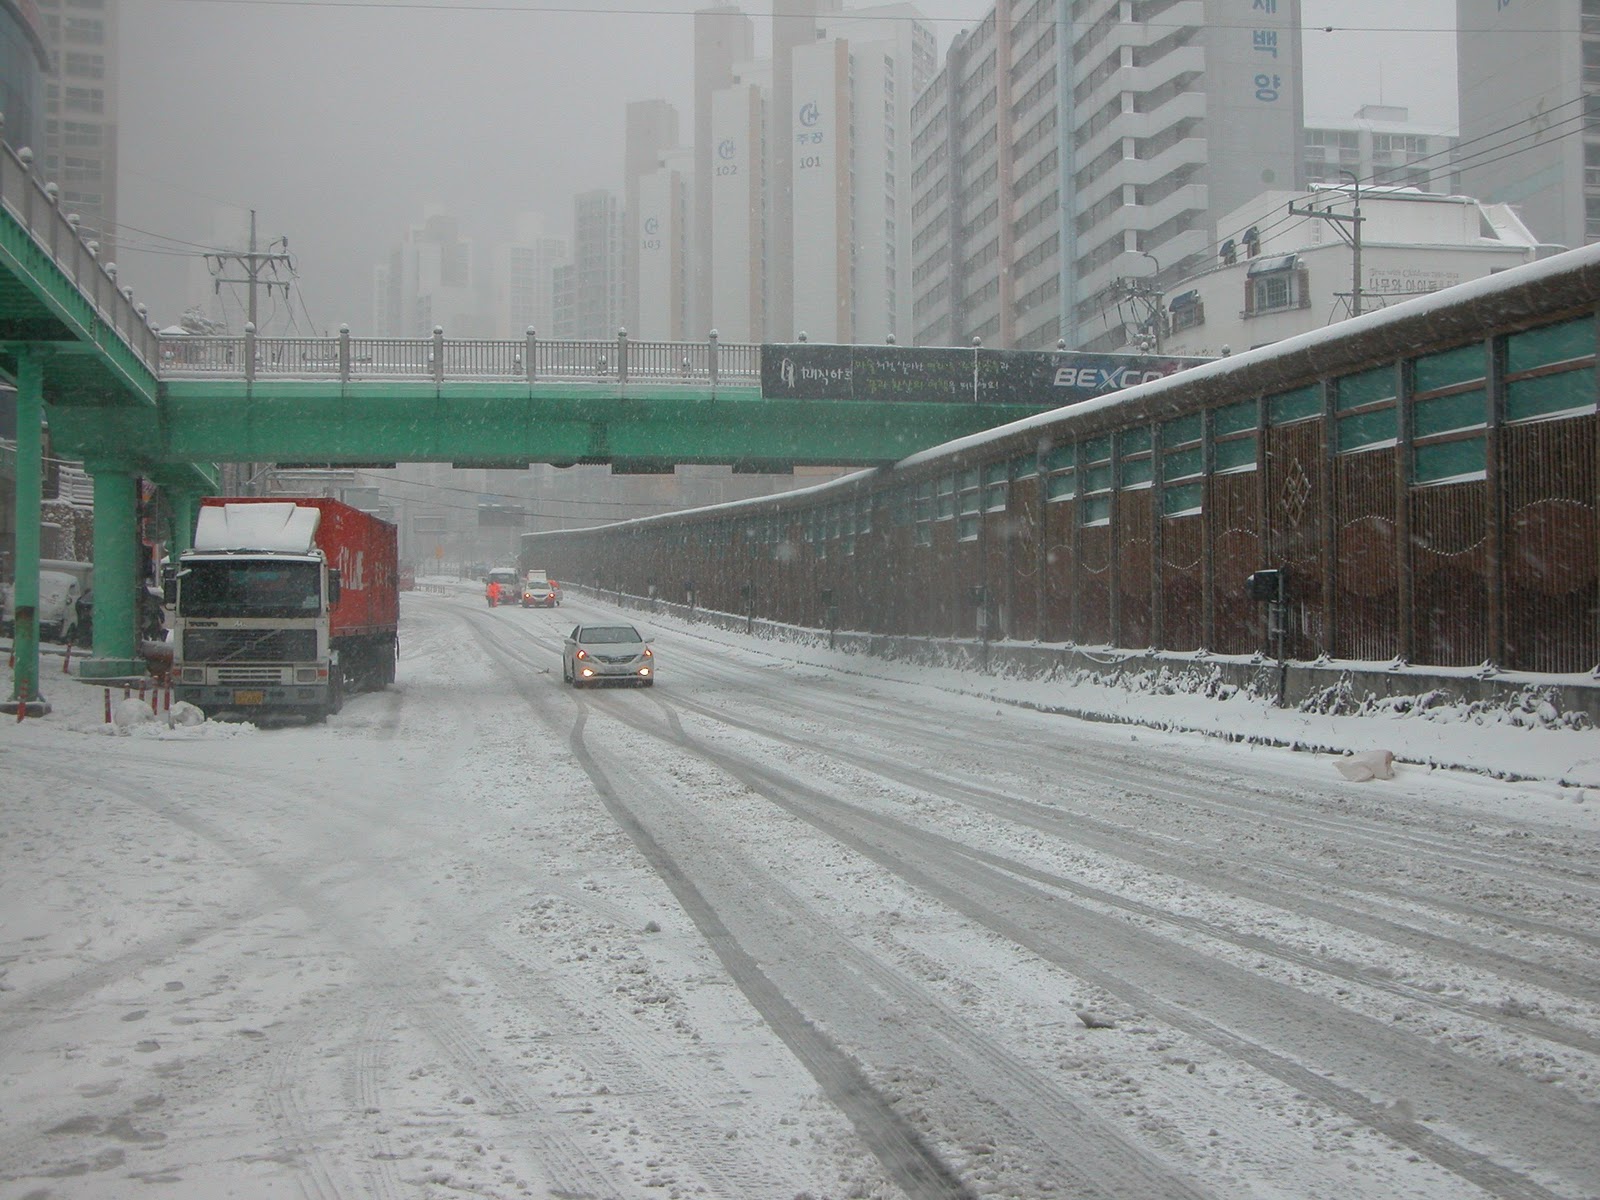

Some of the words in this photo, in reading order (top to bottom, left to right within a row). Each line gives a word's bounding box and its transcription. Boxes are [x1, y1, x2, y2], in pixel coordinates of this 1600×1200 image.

[800, 156, 821, 169] 101
[716, 165, 737, 176] 102
[642, 239, 661, 249] 103
[1369, 278, 1402, 292] 나무와
